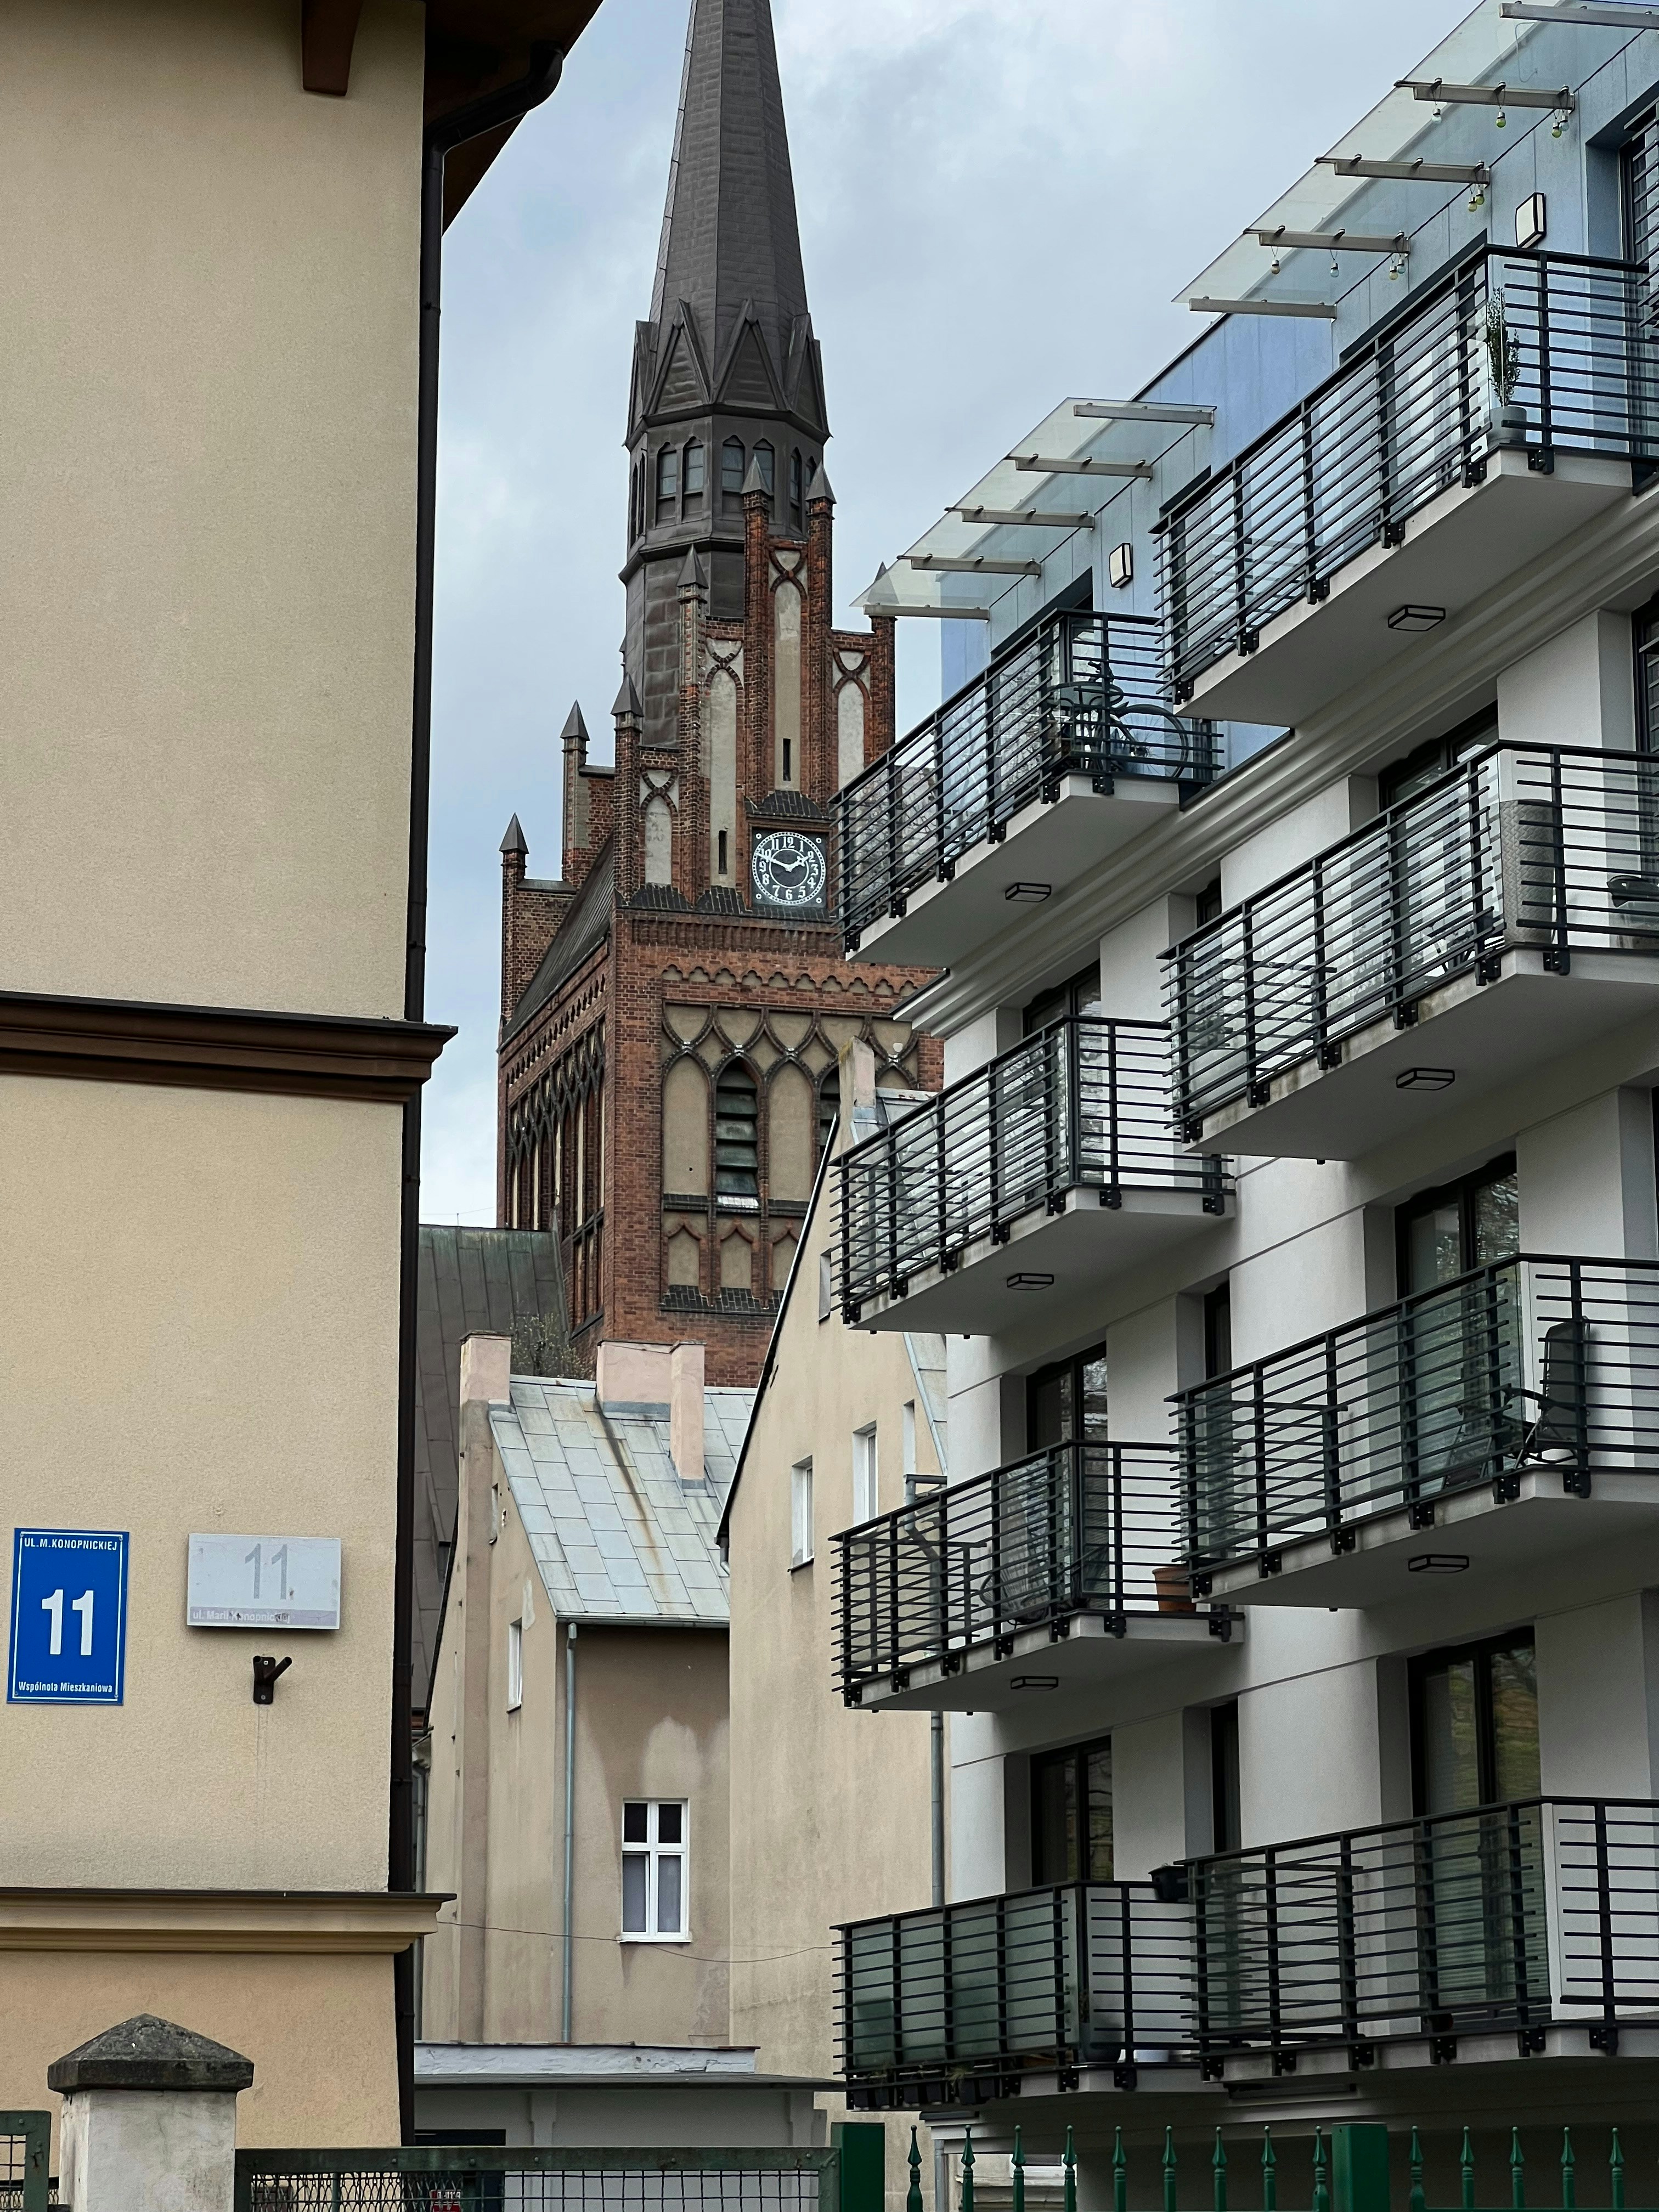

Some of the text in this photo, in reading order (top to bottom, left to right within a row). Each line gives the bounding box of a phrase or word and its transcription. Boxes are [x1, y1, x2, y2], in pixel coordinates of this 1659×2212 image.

[771, 838, 779, 850] 11
[782, 837, 795, 848] 12
[799, 840, 804, 852] 1
[808, 851, 815, 862] 2
[759, 861, 766, 872] 9
[811, 864, 819, 876] 3
[763, 873, 770, 885] 8
[807, 877, 816, 889] 4
[772, 885, 780, 897] 7
[786, 889, 793, 900] 6
[798, 886, 806, 898] 5
[245, 1543, 287, 1600] 11
[193, 1610, 204, 1620] ul.
[207, 1610, 229, 1620] Marii
[42, 1589, 94, 1655] 11
[19, 1681, 112, 1692] Wspólnota Mieszkaniowa
